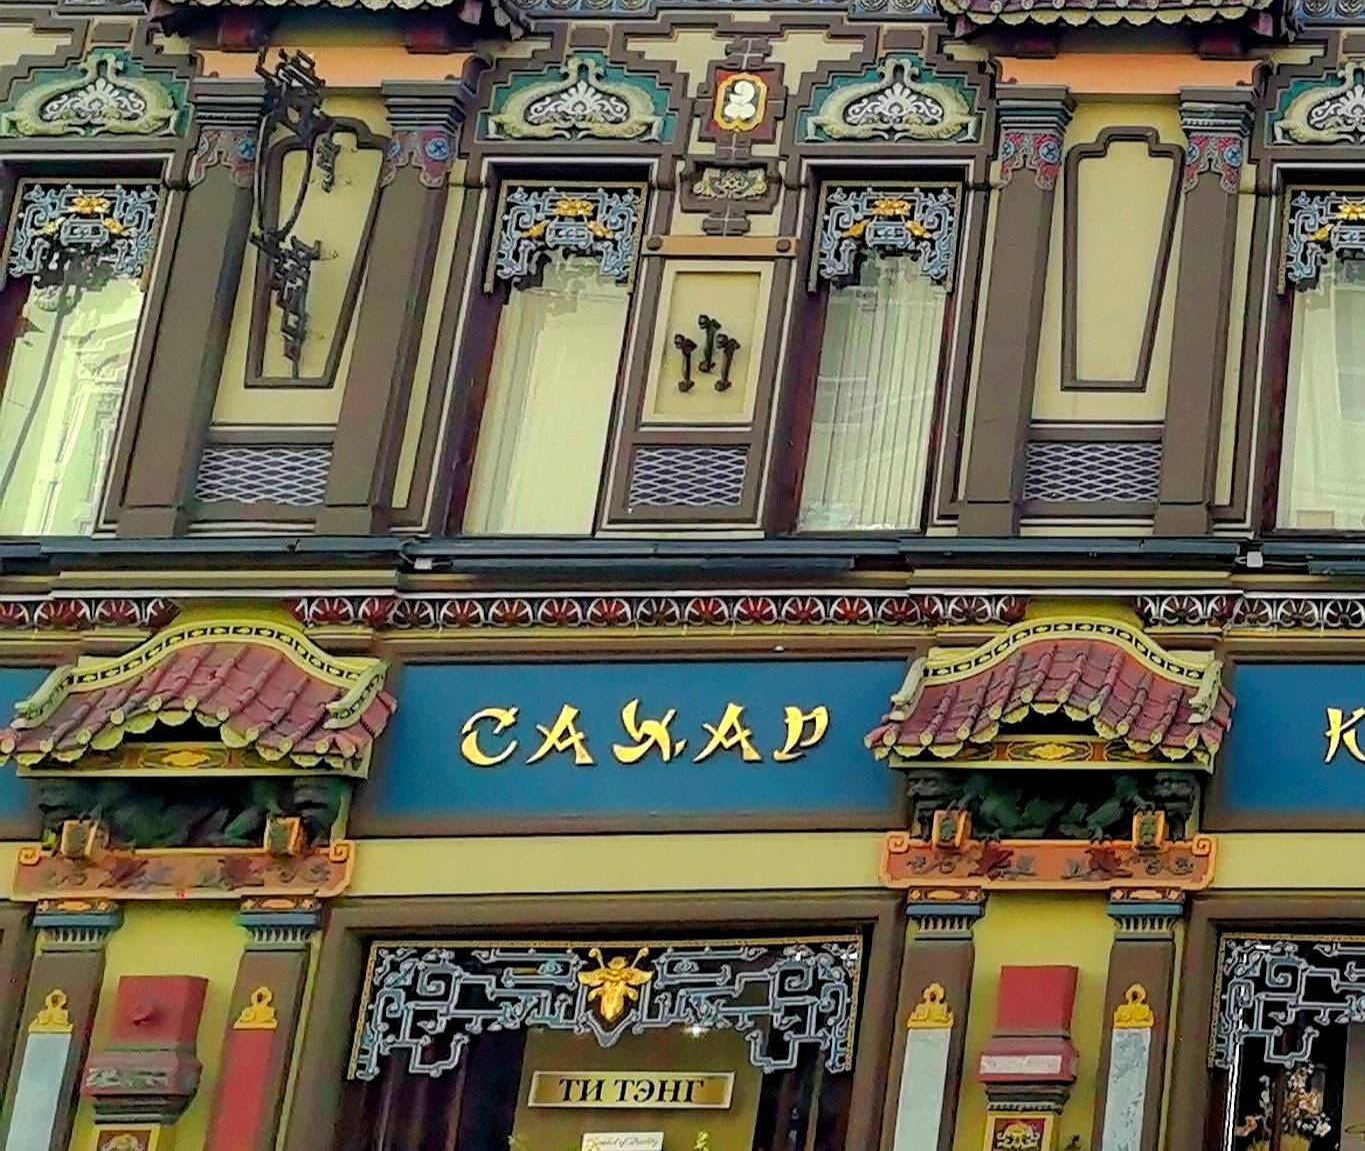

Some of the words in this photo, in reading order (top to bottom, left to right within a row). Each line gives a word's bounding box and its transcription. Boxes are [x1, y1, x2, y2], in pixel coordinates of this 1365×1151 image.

[461, 698, 829, 766] САХАР
[558, 1078, 607, 1102] ТИ
[613, 1078, 705, 1103] ТЭНГ
